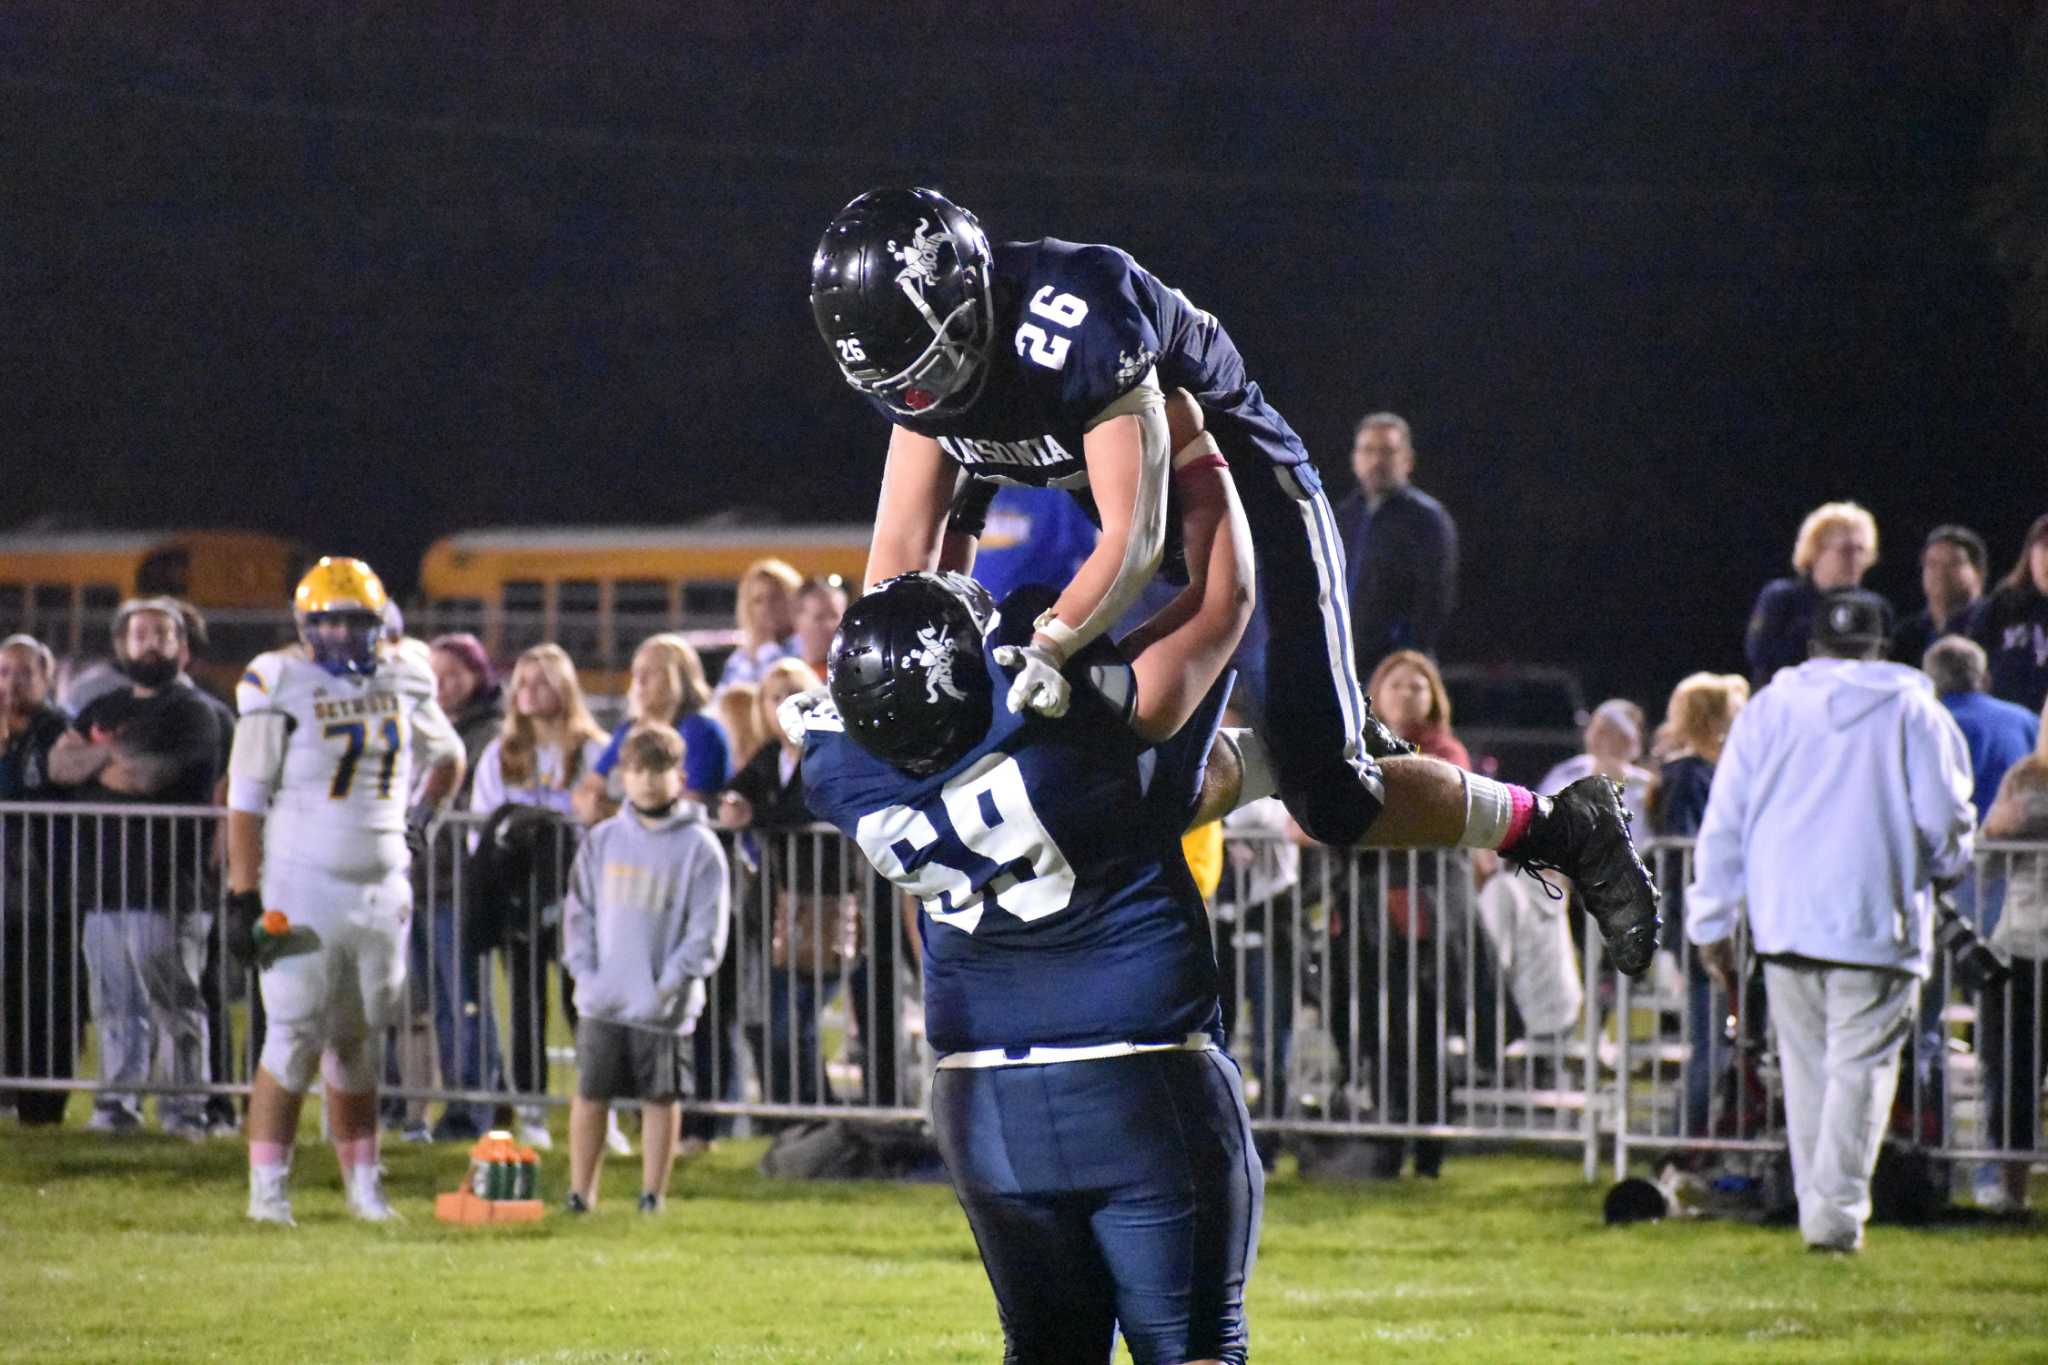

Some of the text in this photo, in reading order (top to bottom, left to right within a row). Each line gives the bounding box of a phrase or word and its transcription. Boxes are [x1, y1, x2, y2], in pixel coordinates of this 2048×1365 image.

[835, 338, 866, 361] 26
[1015, 284, 1089, 371] 26
[323, 715, 402, 801] 71
[856, 752, 1076, 934] 69
